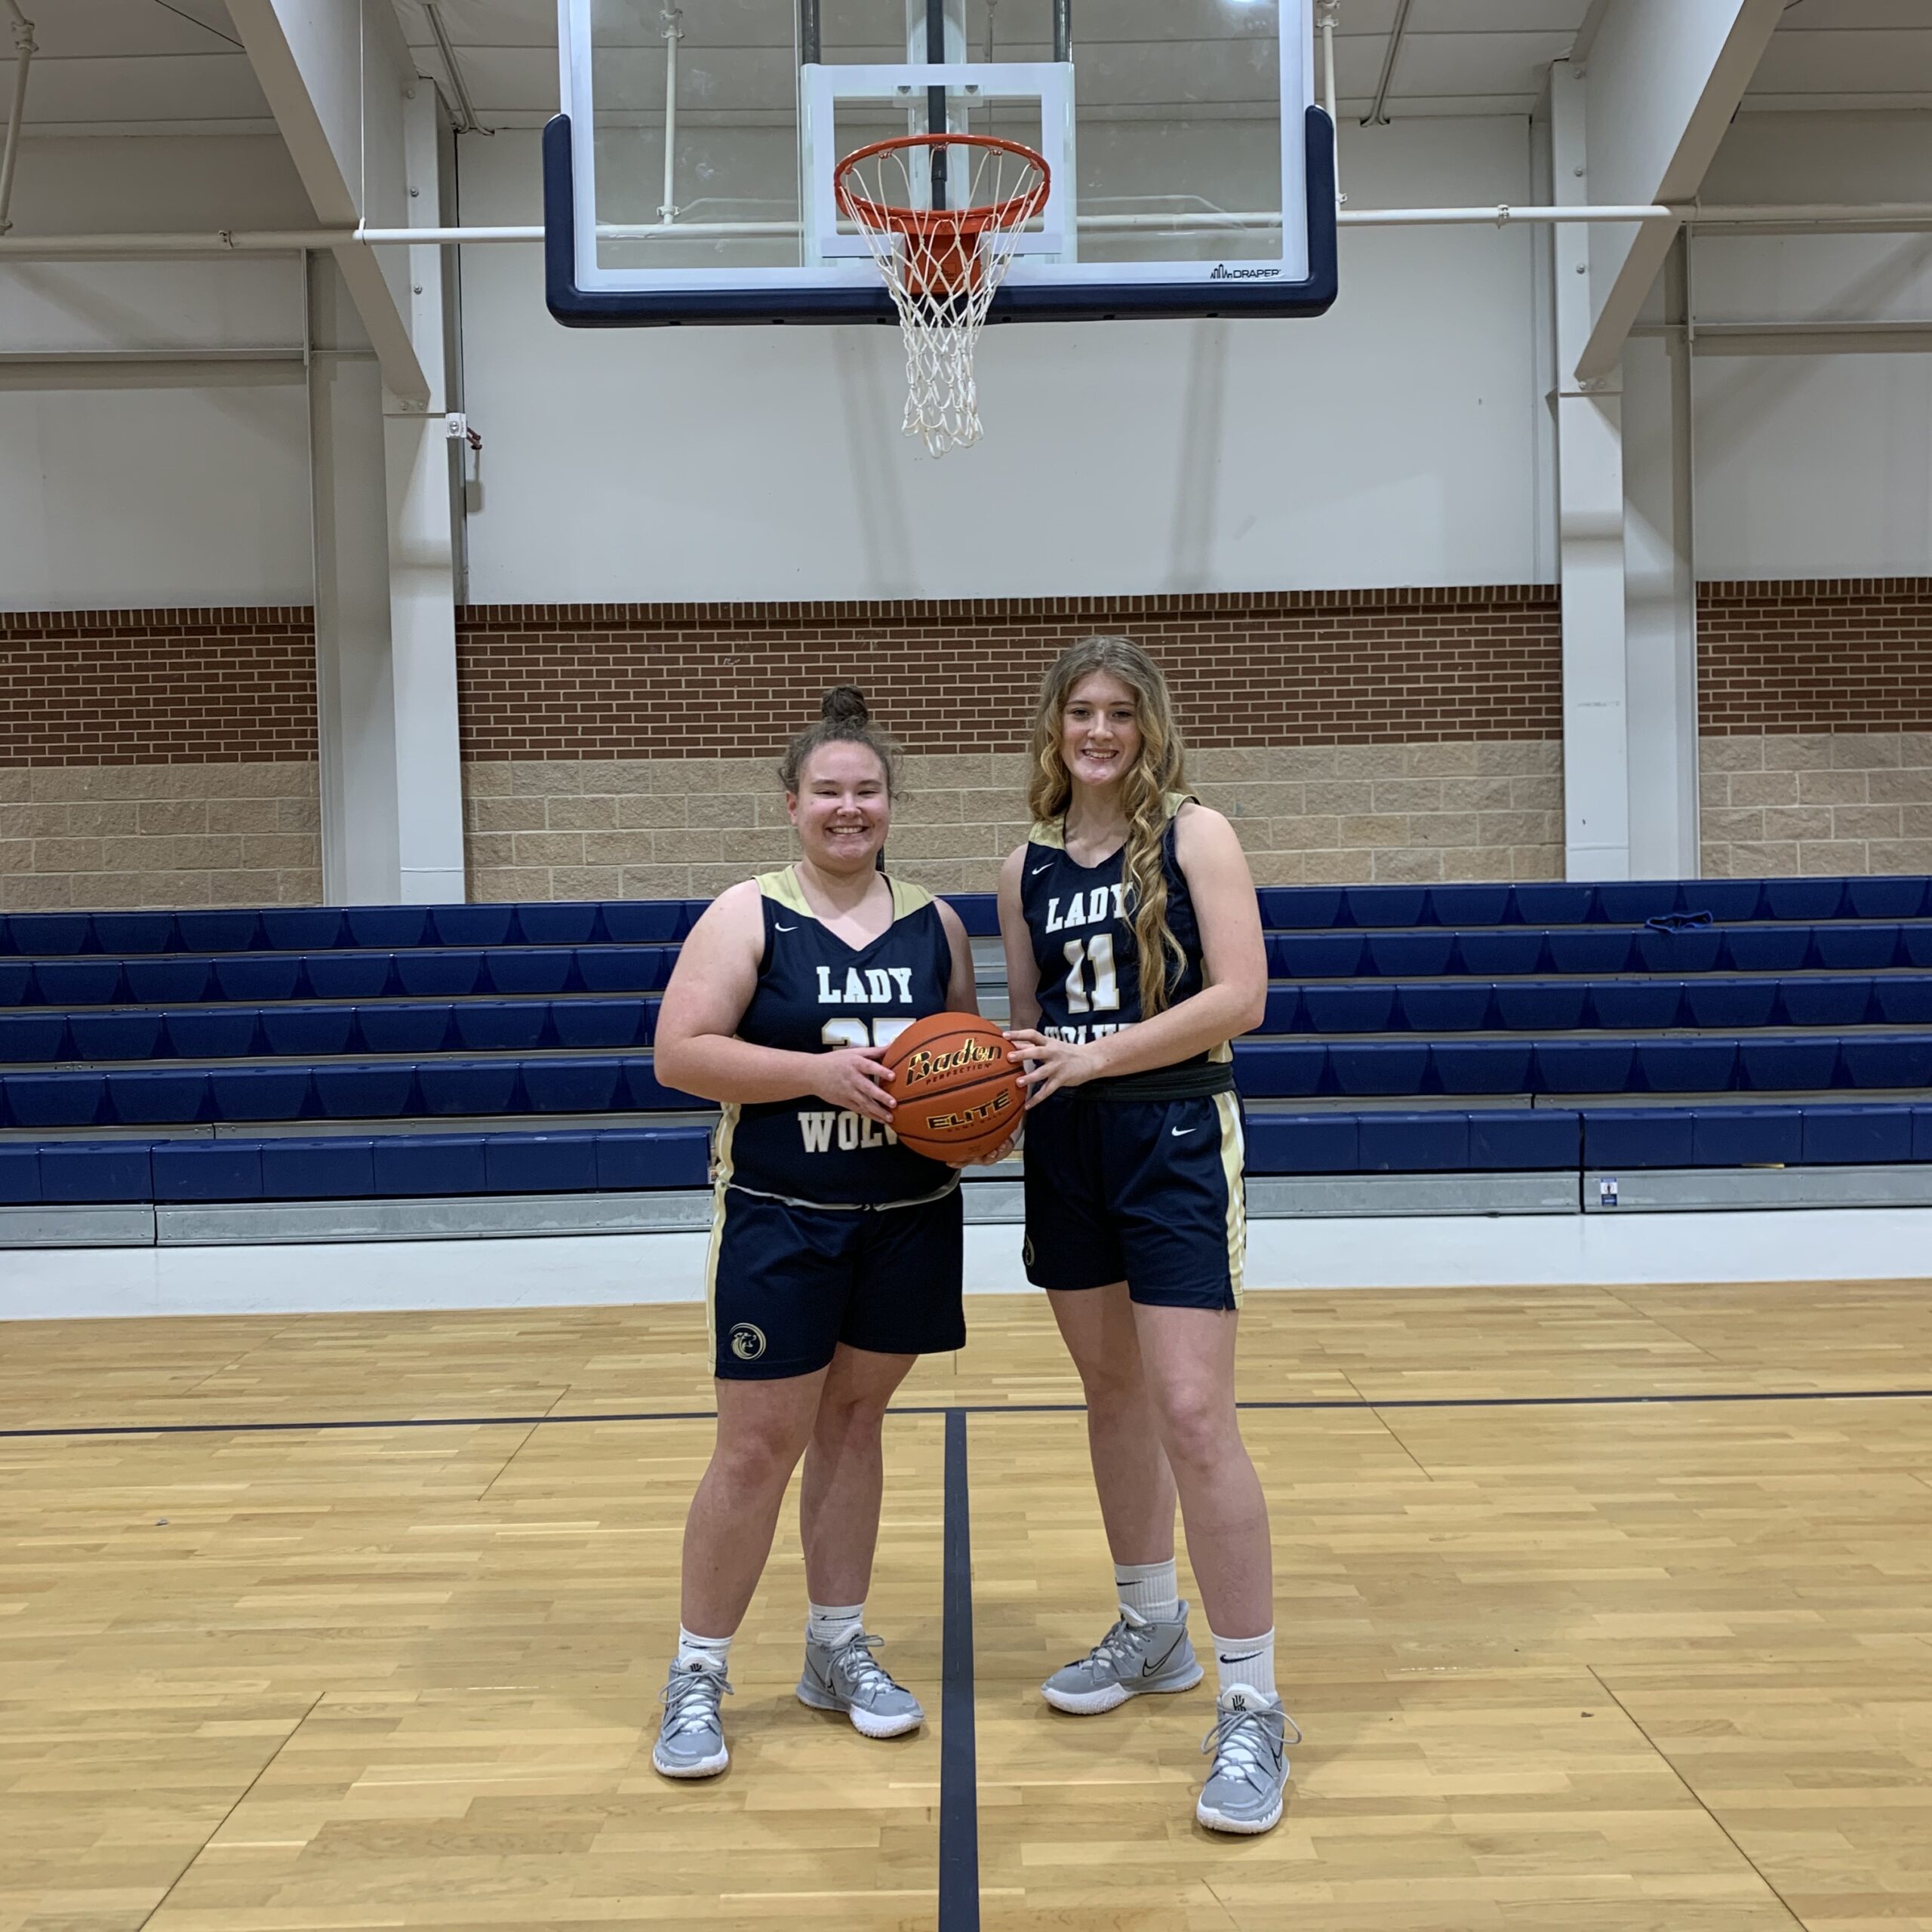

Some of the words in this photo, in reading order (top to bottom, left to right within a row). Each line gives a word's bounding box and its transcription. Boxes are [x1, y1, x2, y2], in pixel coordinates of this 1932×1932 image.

[1233, 269, 1280, 278] DRAPER
[1045, 881, 1134, 934] LADY
[816, 966, 913, 1004] LADY
[1063, 933, 1120, 1014] 11
[906, 1038, 1002, 1087] Baden
[925, 1063, 990, 1085] PERFECTION
[927, 1091, 1013, 1129] ELITE
